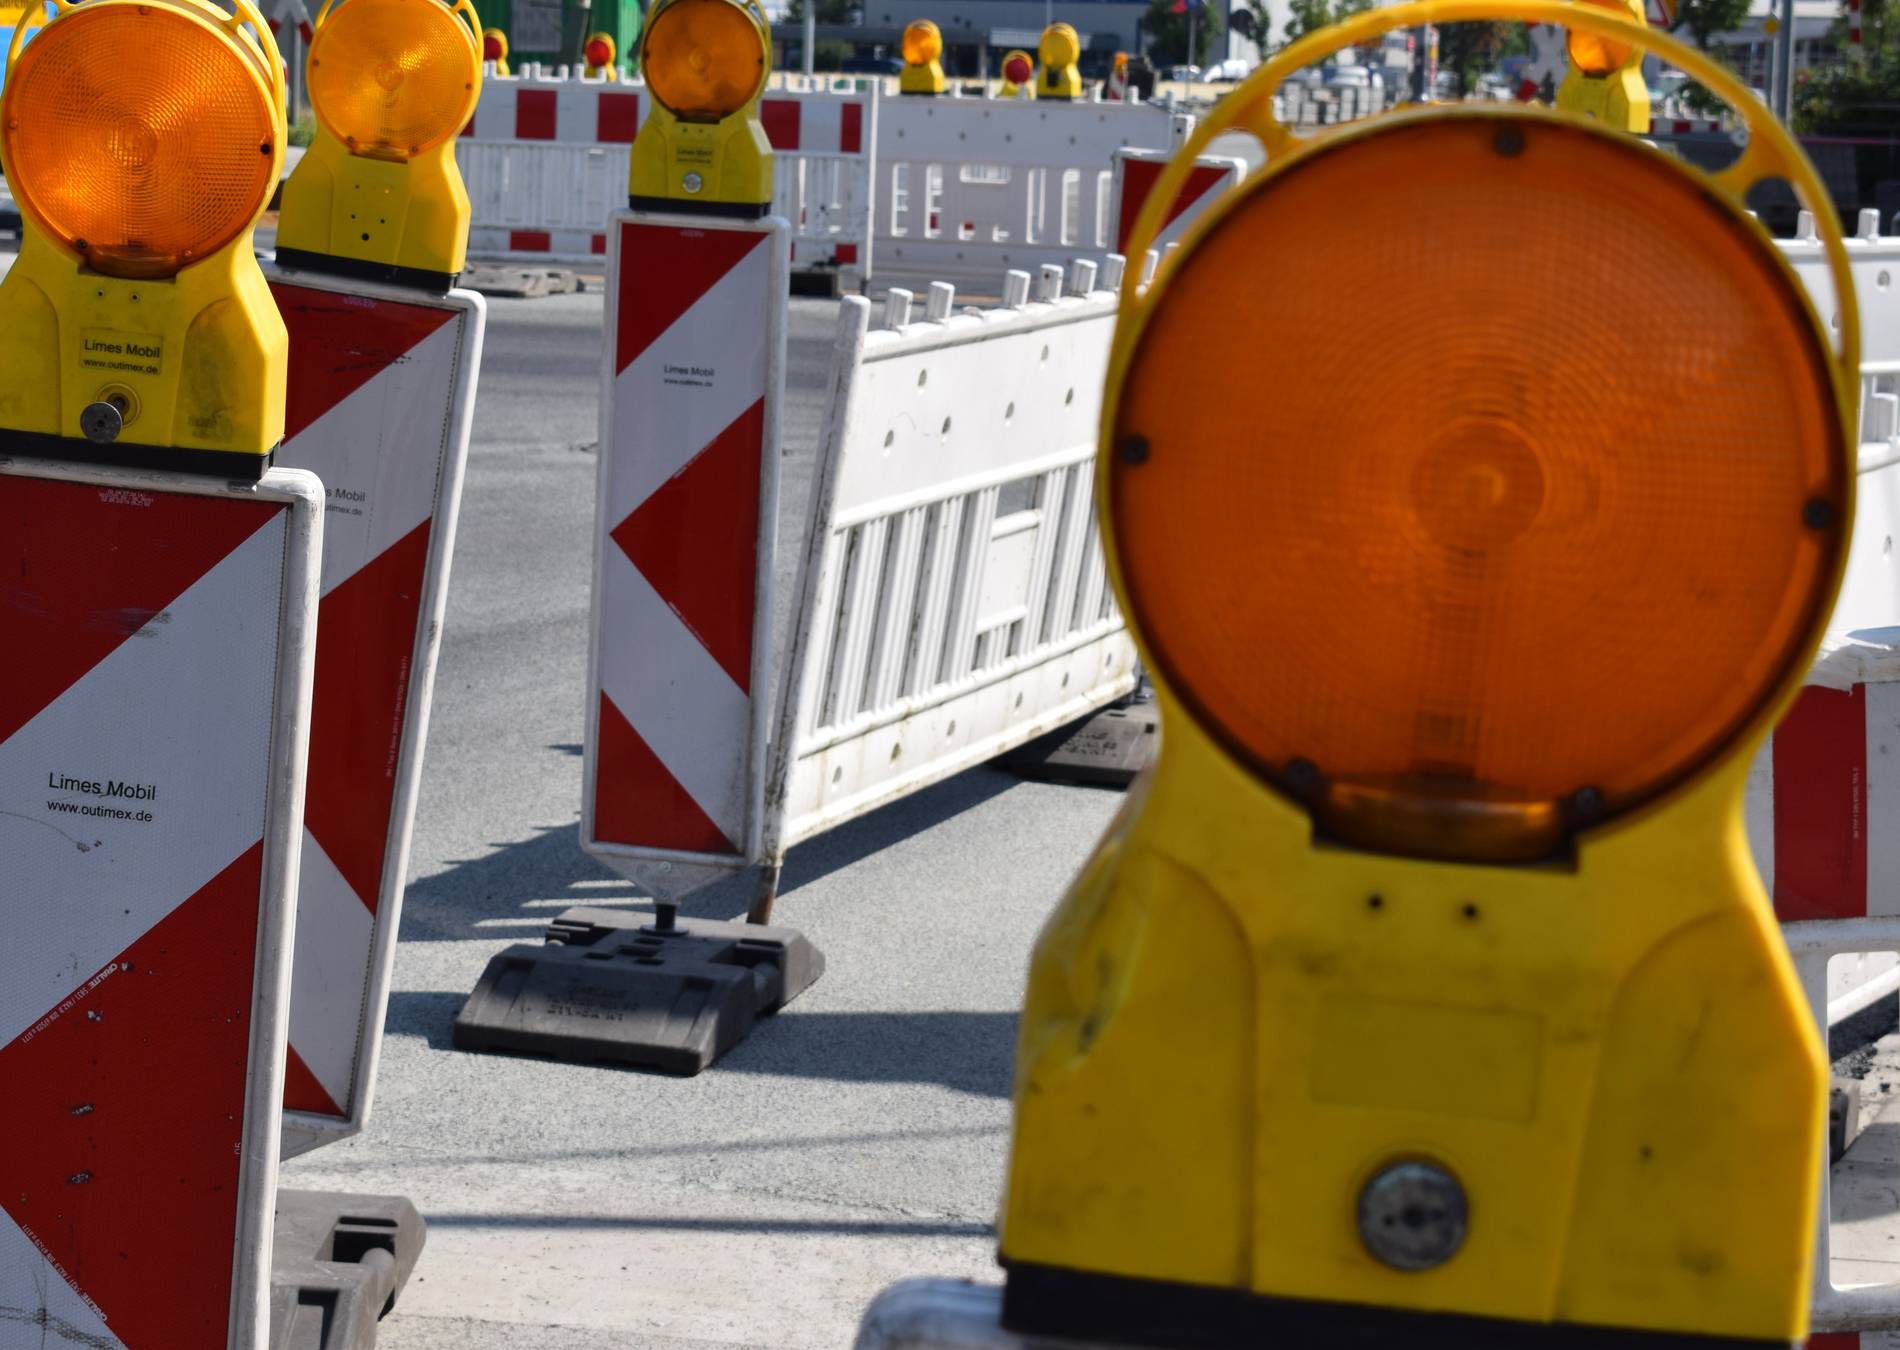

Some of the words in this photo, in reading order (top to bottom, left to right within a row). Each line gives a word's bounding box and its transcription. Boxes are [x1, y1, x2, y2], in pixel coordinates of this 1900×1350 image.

[84, 339, 122, 354] Limes
[126, 344, 160, 358] Mobil
[336, 488, 366, 502] Mobil
[49, 772, 102, 795] Limes
[106, 781, 156, 801] Mobil
[47, 801, 153, 822] www.outimex.de
